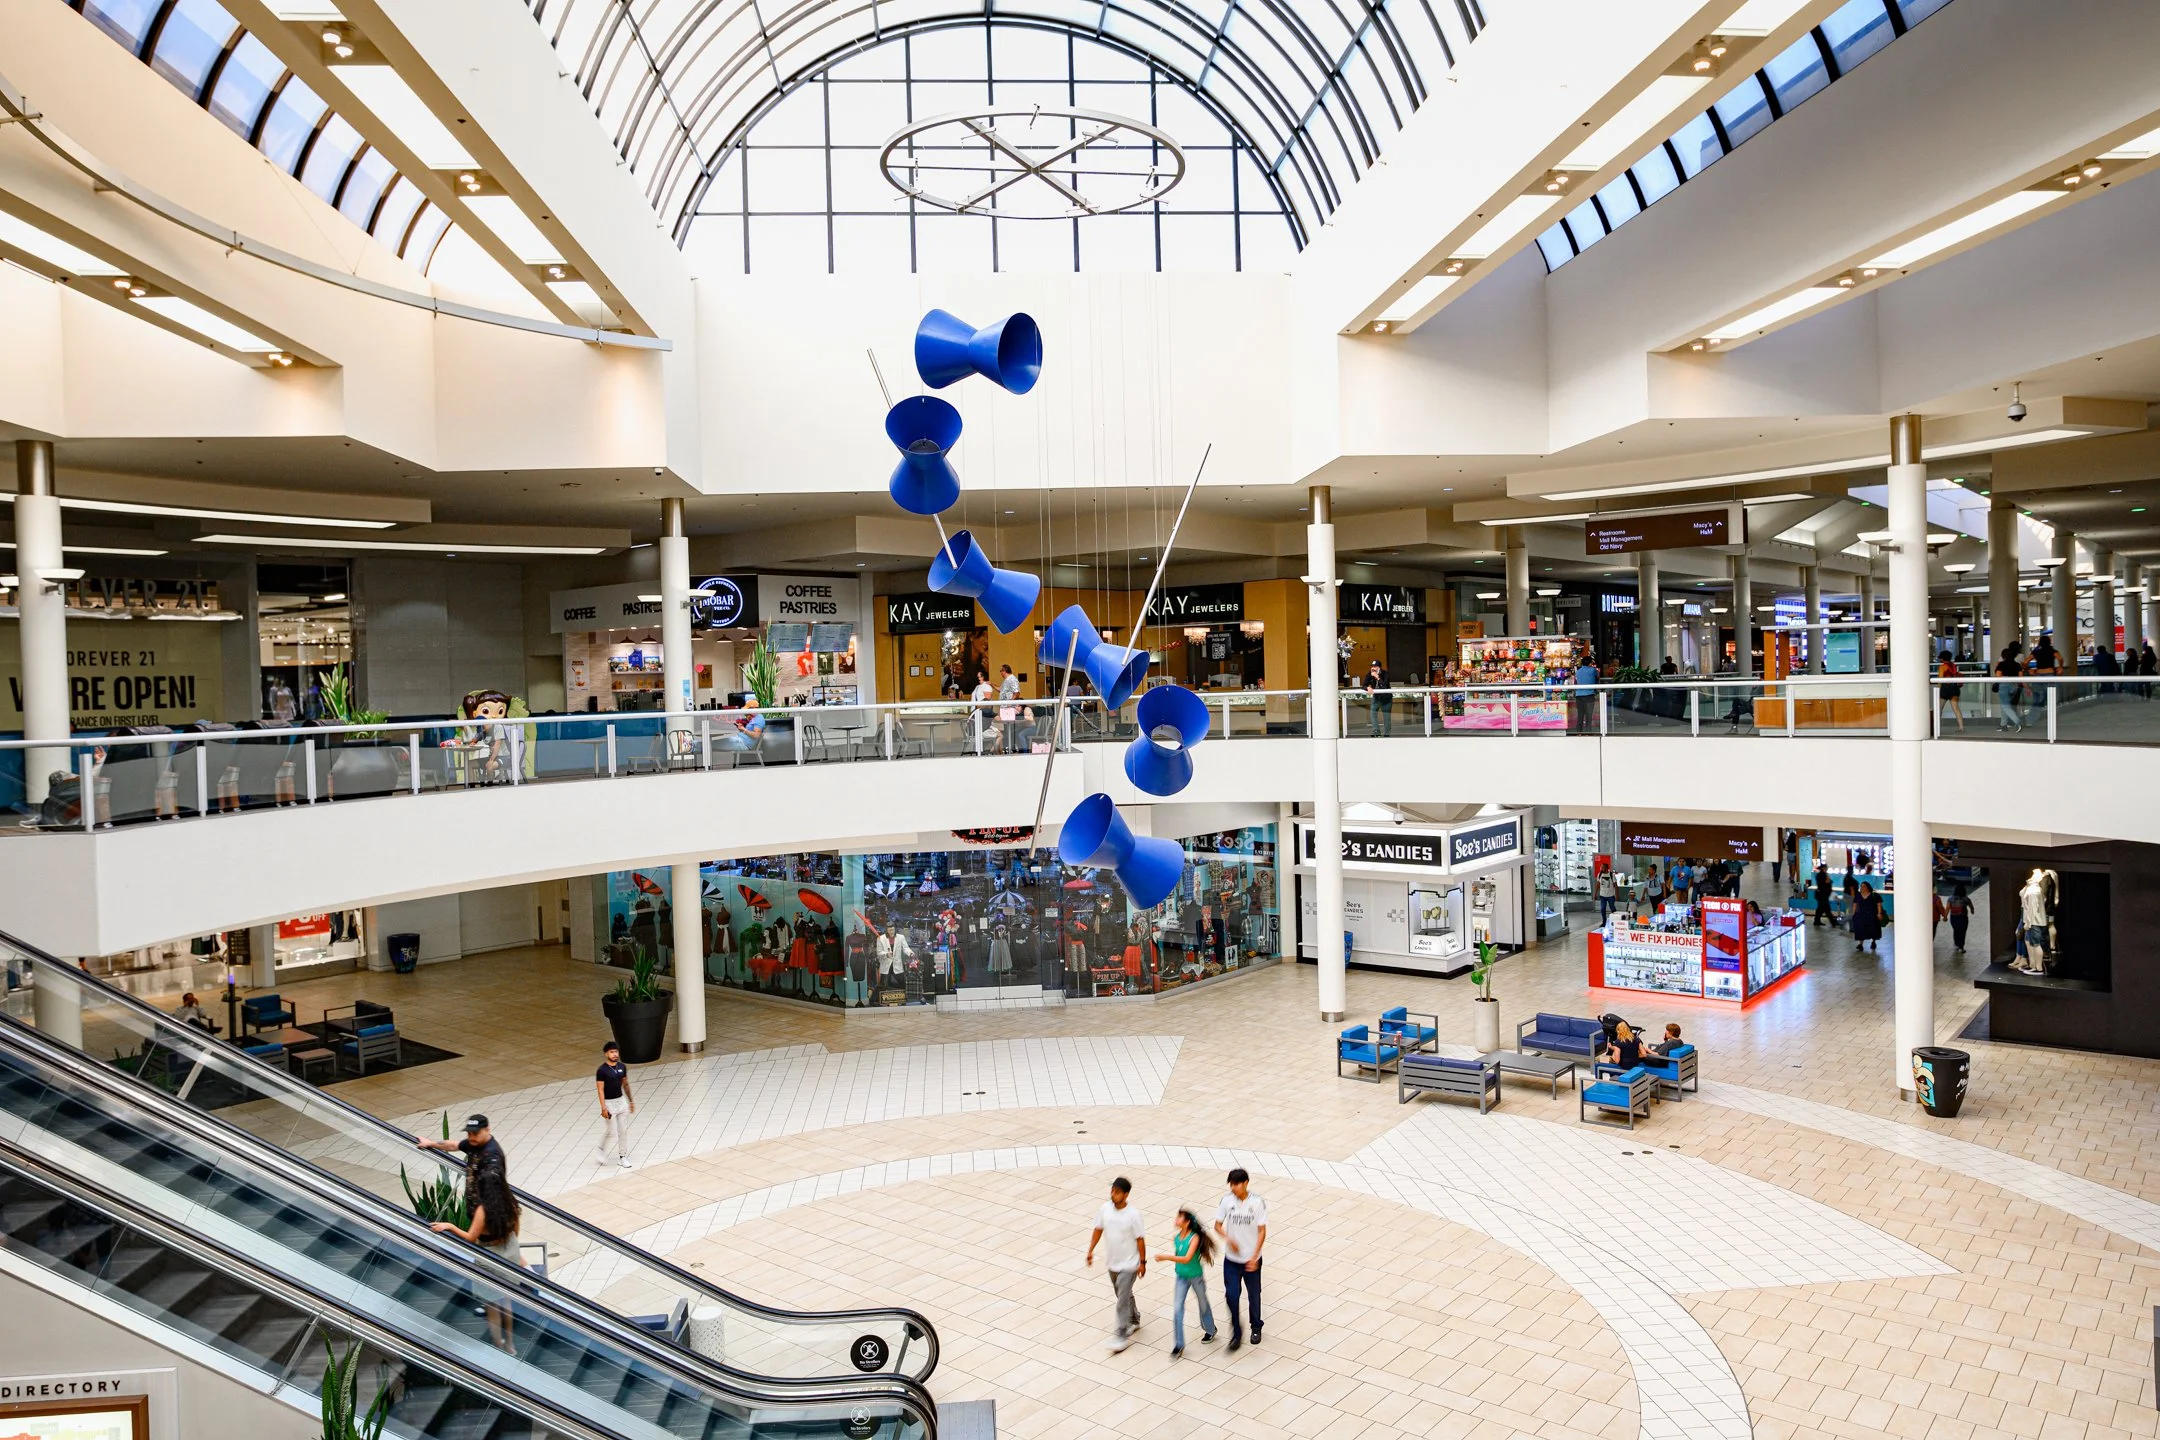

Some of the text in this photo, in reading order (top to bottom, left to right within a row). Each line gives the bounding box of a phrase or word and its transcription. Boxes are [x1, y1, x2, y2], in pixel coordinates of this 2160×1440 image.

[1611, 535, 1643, 543] Management
[784, 585, 832, 597] COFFEE
[702, 594, 734, 606] MOBAR
[780, 601, 837, 614] PASTRIES
[1148, 595, 1239, 616] KAY JEWELERS
[1361, 593, 1392, 611] KAY
[563, 601, 662, 621] COFFEE PASTR
[889, 602, 970, 623] KAY JEWELERS
[67, 651, 156, 666] OREVER 21
[9, 675, 197, 712] W'RE OPEN!
[70, 714, 160, 727] RANCE ON FIRST LEVEL
[1455, 833, 1512, 859] See's CANDIES
[1653, 836, 1685, 844] Management
[1366, 845, 1433, 861] CANDIES
[1346, 900, 1361, 908] See's
[1703, 901, 1741, 911] TECH FIX
[1630, 932, 1703, 948] WE FIX PHONES
[1, 1380, 121, 1398] DIRECTORY
